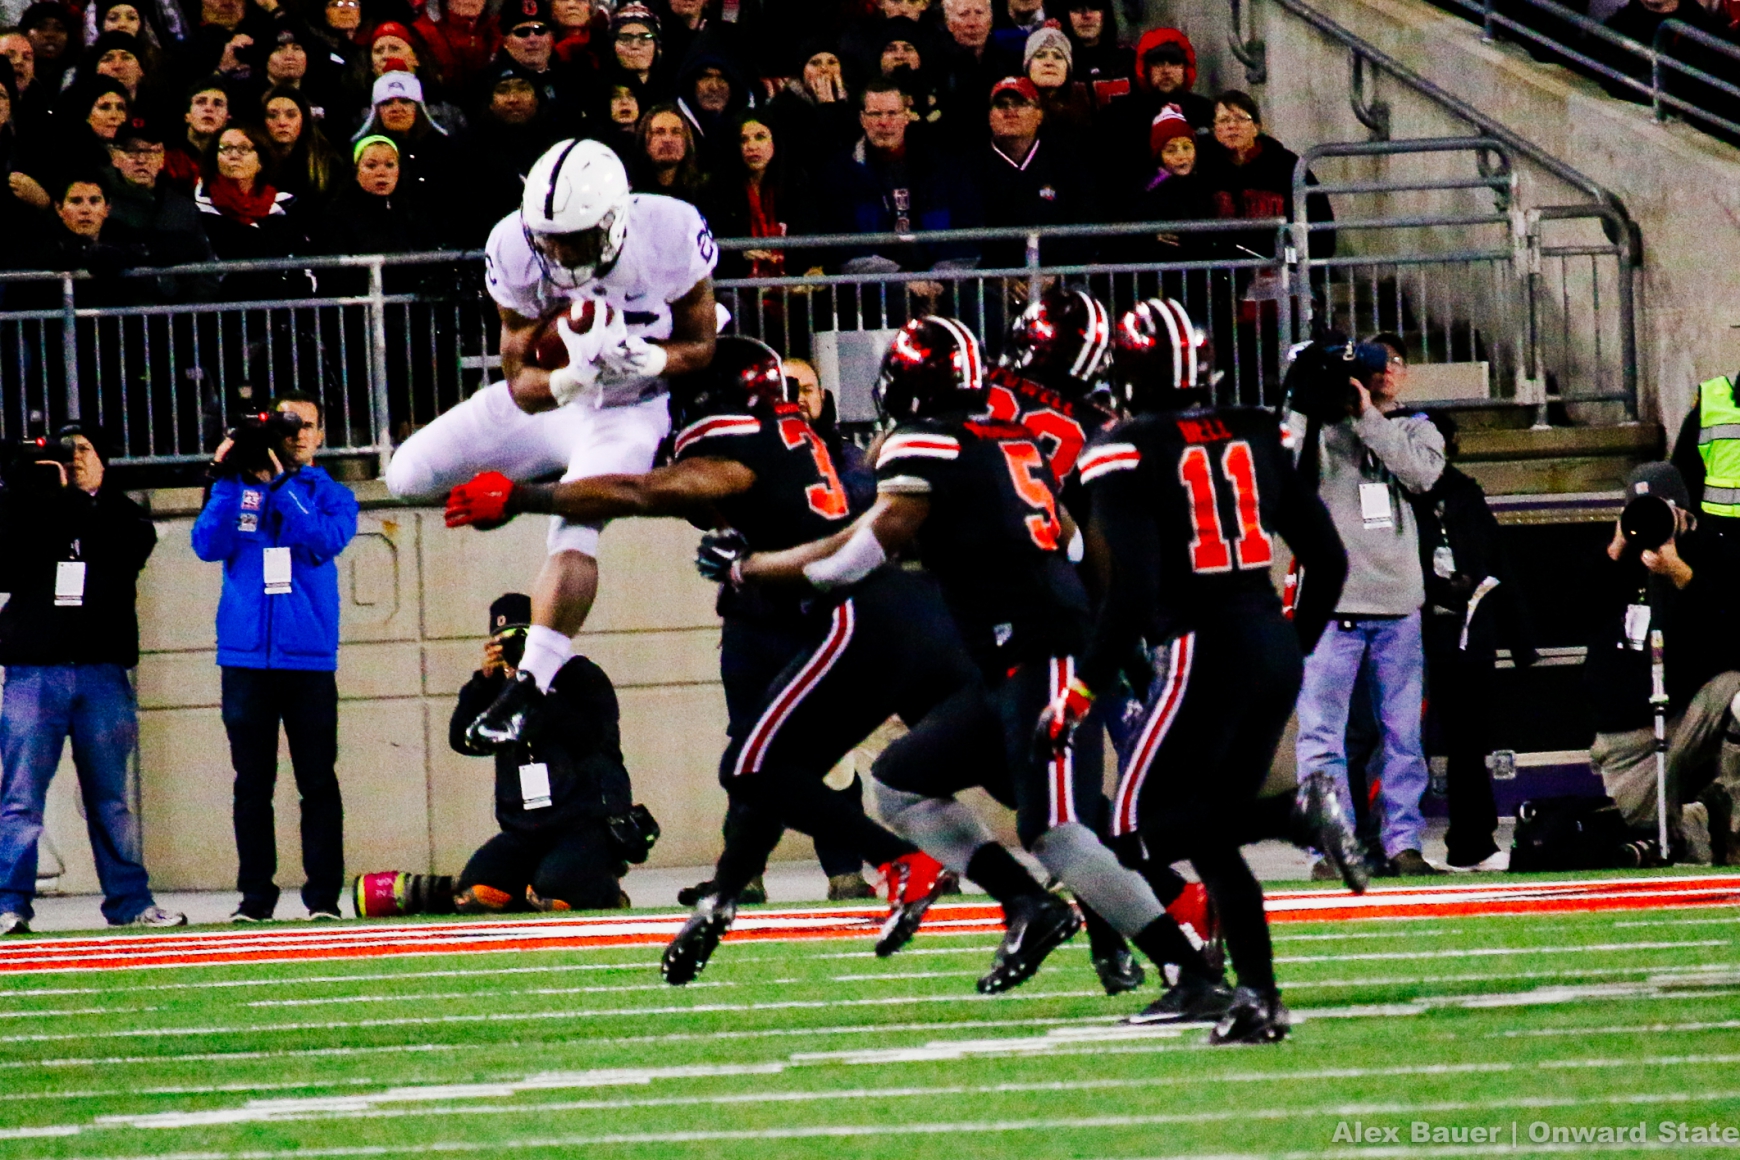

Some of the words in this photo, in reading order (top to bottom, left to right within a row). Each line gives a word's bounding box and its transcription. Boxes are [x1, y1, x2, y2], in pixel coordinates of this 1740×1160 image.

[777, 416, 850, 520] 3
[998, 440, 1061, 551] 5
[1178, 440, 1274, 573] 11
